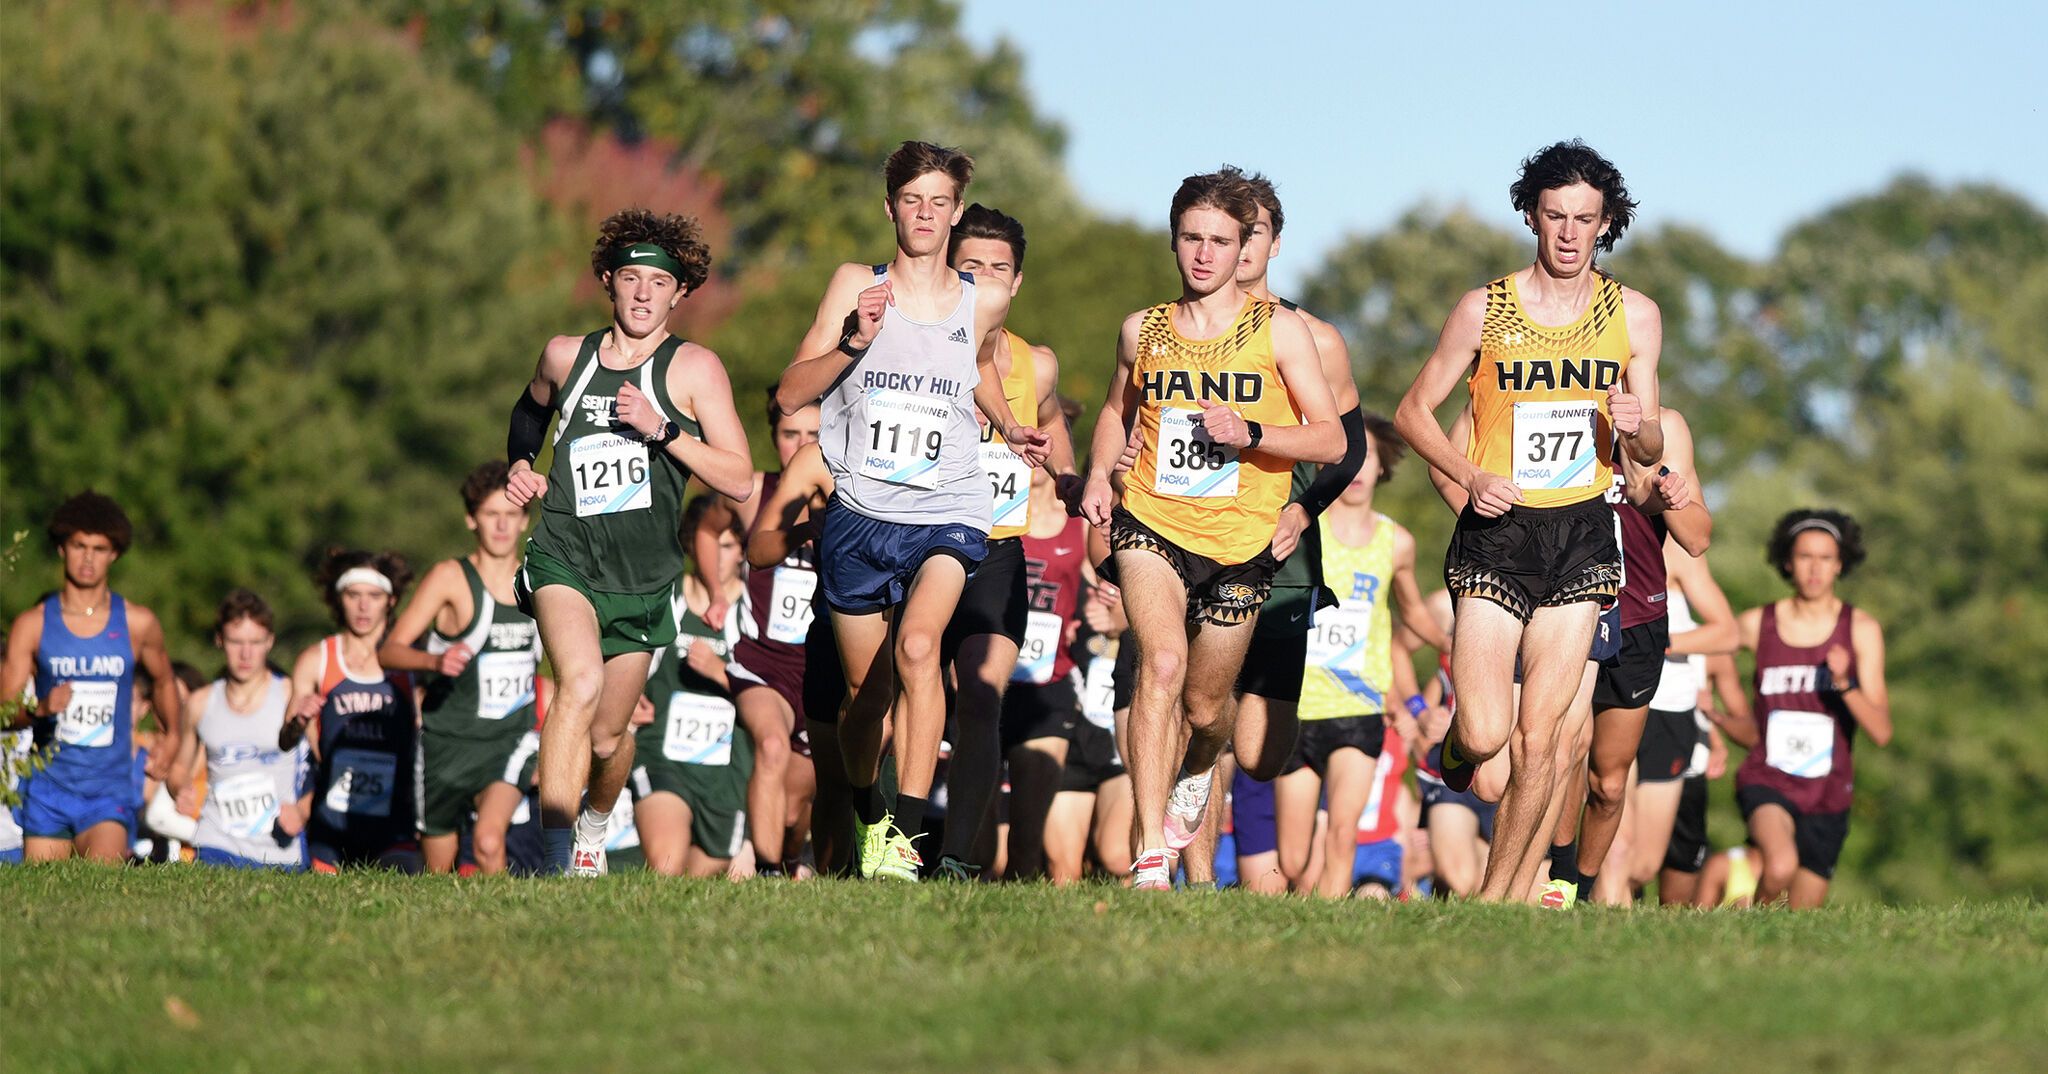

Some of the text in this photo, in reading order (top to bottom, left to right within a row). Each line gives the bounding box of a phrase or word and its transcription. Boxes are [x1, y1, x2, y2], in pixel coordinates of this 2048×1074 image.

[947, 335, 969, 344] adidas
[864, 371, 925, 392] ROCKY
[1142, 370, 1263, 403] HAND
[1494, 358, 1621, 392] HAND
[870, 399, 949, 419] soundRUNNER
[870, 420, 942, 461] 1119
[1528, 431, 1584, 463] 377
[865, 456, 896, 471] HOKA
[1169, 438, 1226, 471] 385
[576, 456, 646, 490] 1216
[1160, 473, 1190, 486] HOKA
[1517, 468, 1551, 479] HOKA
[579, 494, 608, 507] HOKA
[782, 595, 812, 621] 97
[1316, 623, 1357, 648] 163
[49, 655, 124, 677] TOLLAND
[675, 718, 729, 743] 1212
[224, 792, 275, 817] 1070
